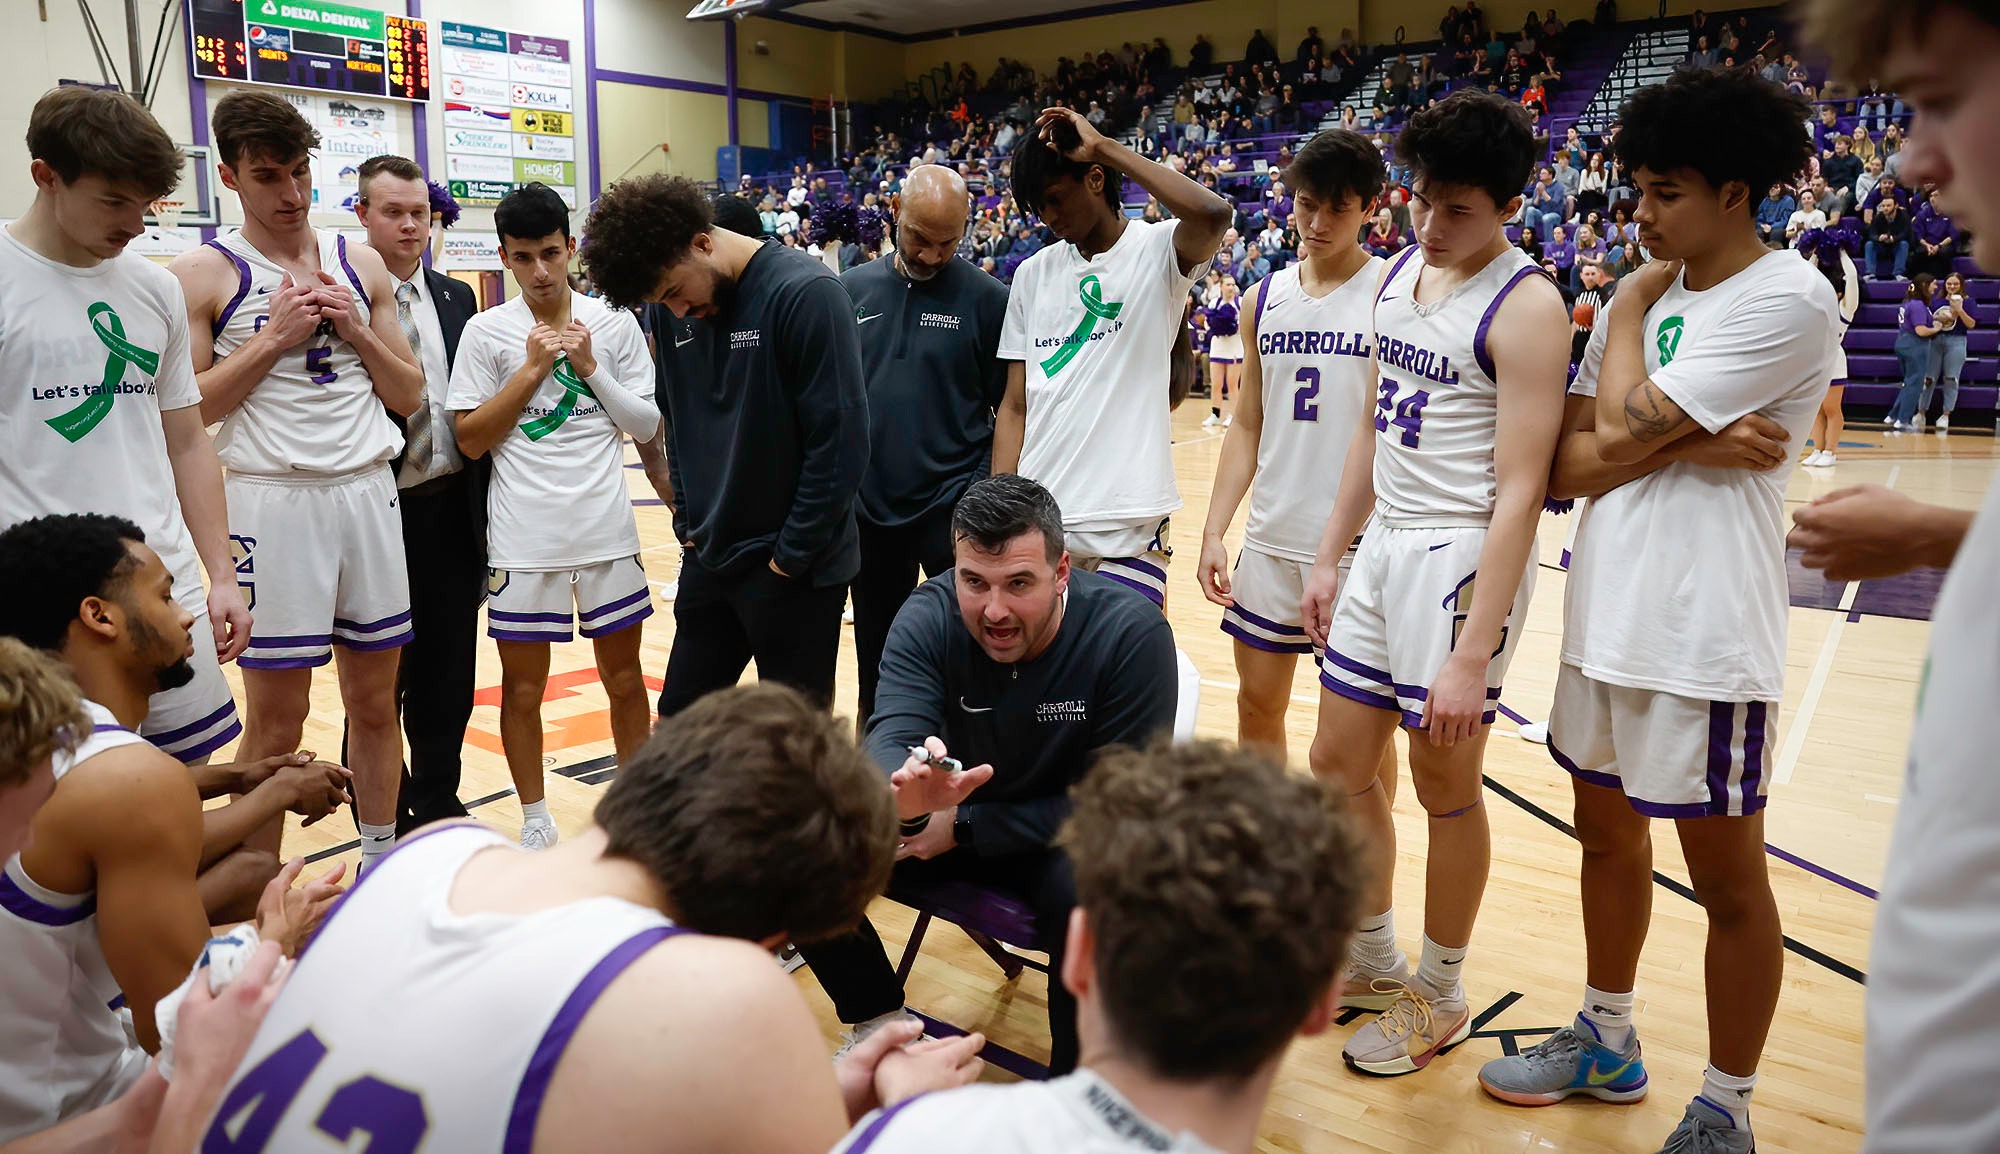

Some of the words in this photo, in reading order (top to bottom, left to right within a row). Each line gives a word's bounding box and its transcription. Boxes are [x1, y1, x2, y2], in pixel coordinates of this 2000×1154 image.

[281, 5, 320, 22] DELTA
[321, 11, 370, 30] DENTAL
[528, 90, 557, 104] KXLH
[327, 139, 389, 158] Intrepid
[921, 312, 960, 324] CARROLL
[1035, 337, 1060, 348] Let's
[1260, 331, 1371, 359] CARROLL
[305, 345, 339, 386] 5
[32, 384, 79, 401] Let's
[1292, 366, 1321, 422] 2
[568, 404, 598, 417] about
[1375, 377, 1430, 450] 24
[1036, 700, 1086, 714] CARROLL
